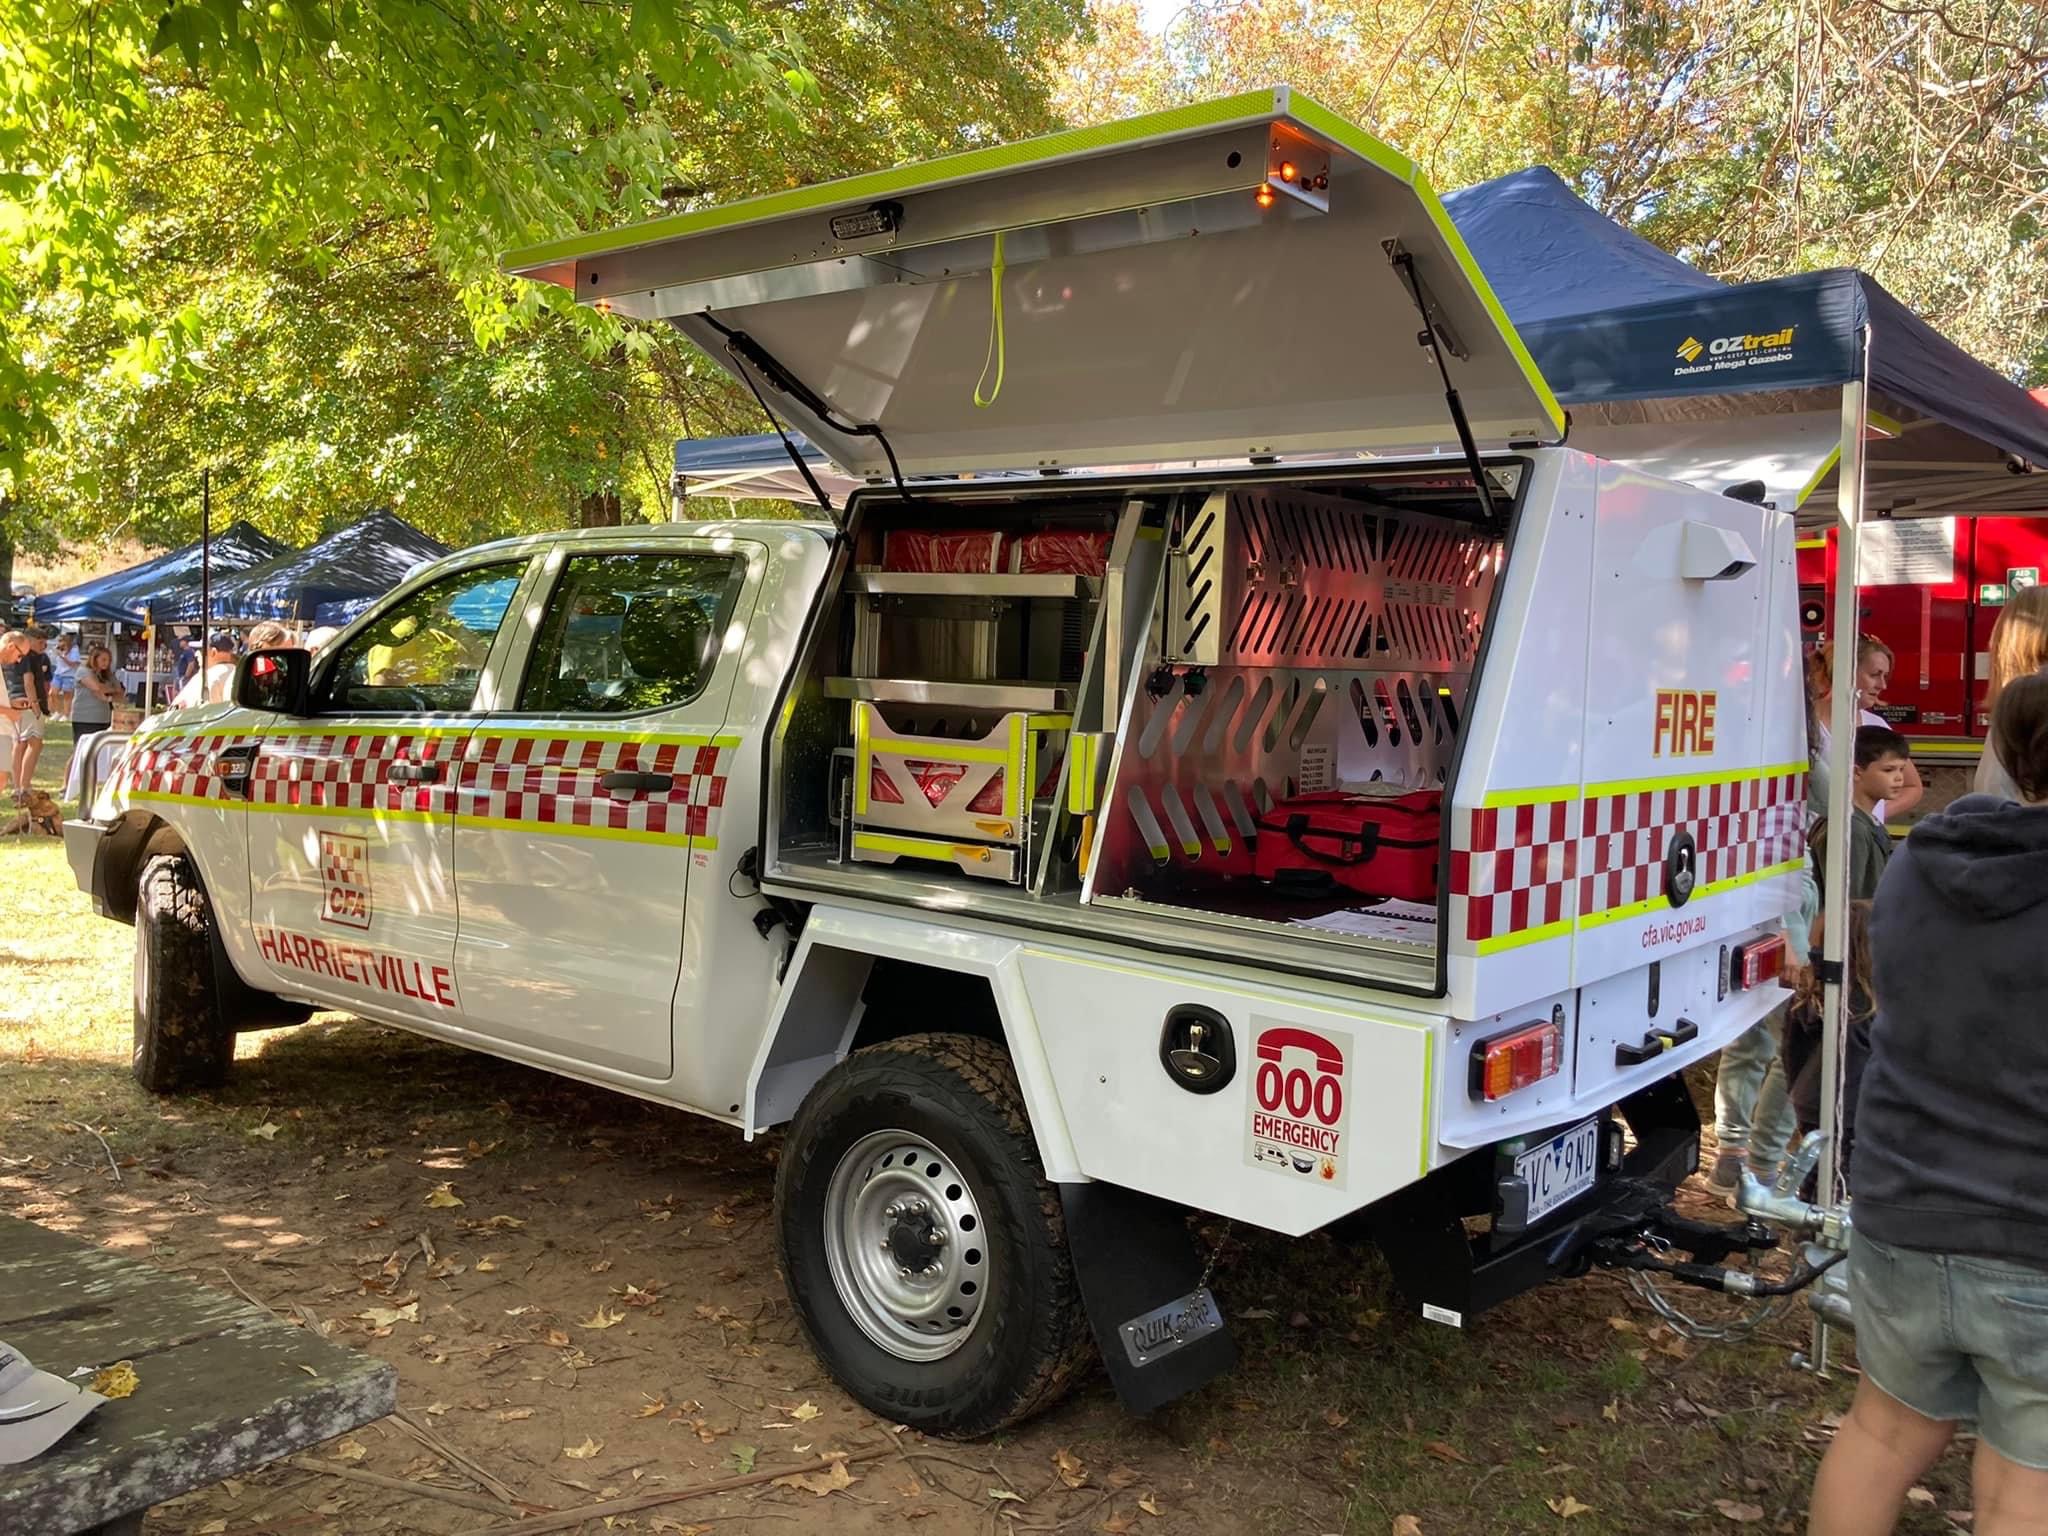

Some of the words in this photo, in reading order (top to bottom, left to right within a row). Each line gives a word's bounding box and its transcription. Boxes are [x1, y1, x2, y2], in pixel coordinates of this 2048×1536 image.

[1709, 327, 1794, 354] OZtrail
[1674, 364, 1712, 376] Deluxe
[1714, 359, 1746, 371] Mega
[1748, 353, 1793, 366] Gazebo
[1653, 689, 1717, 758] FIRE
[329, 887, 366, 919] CFA
[1641, 915, 1706, 948] cfa.vic.gov.au
[259, 928, 456, 1007] HARRIETVILLE
[1256, 1061, 1343, 1126] 000
[1253, 1113, 1340, 1154] EMERGENCY
